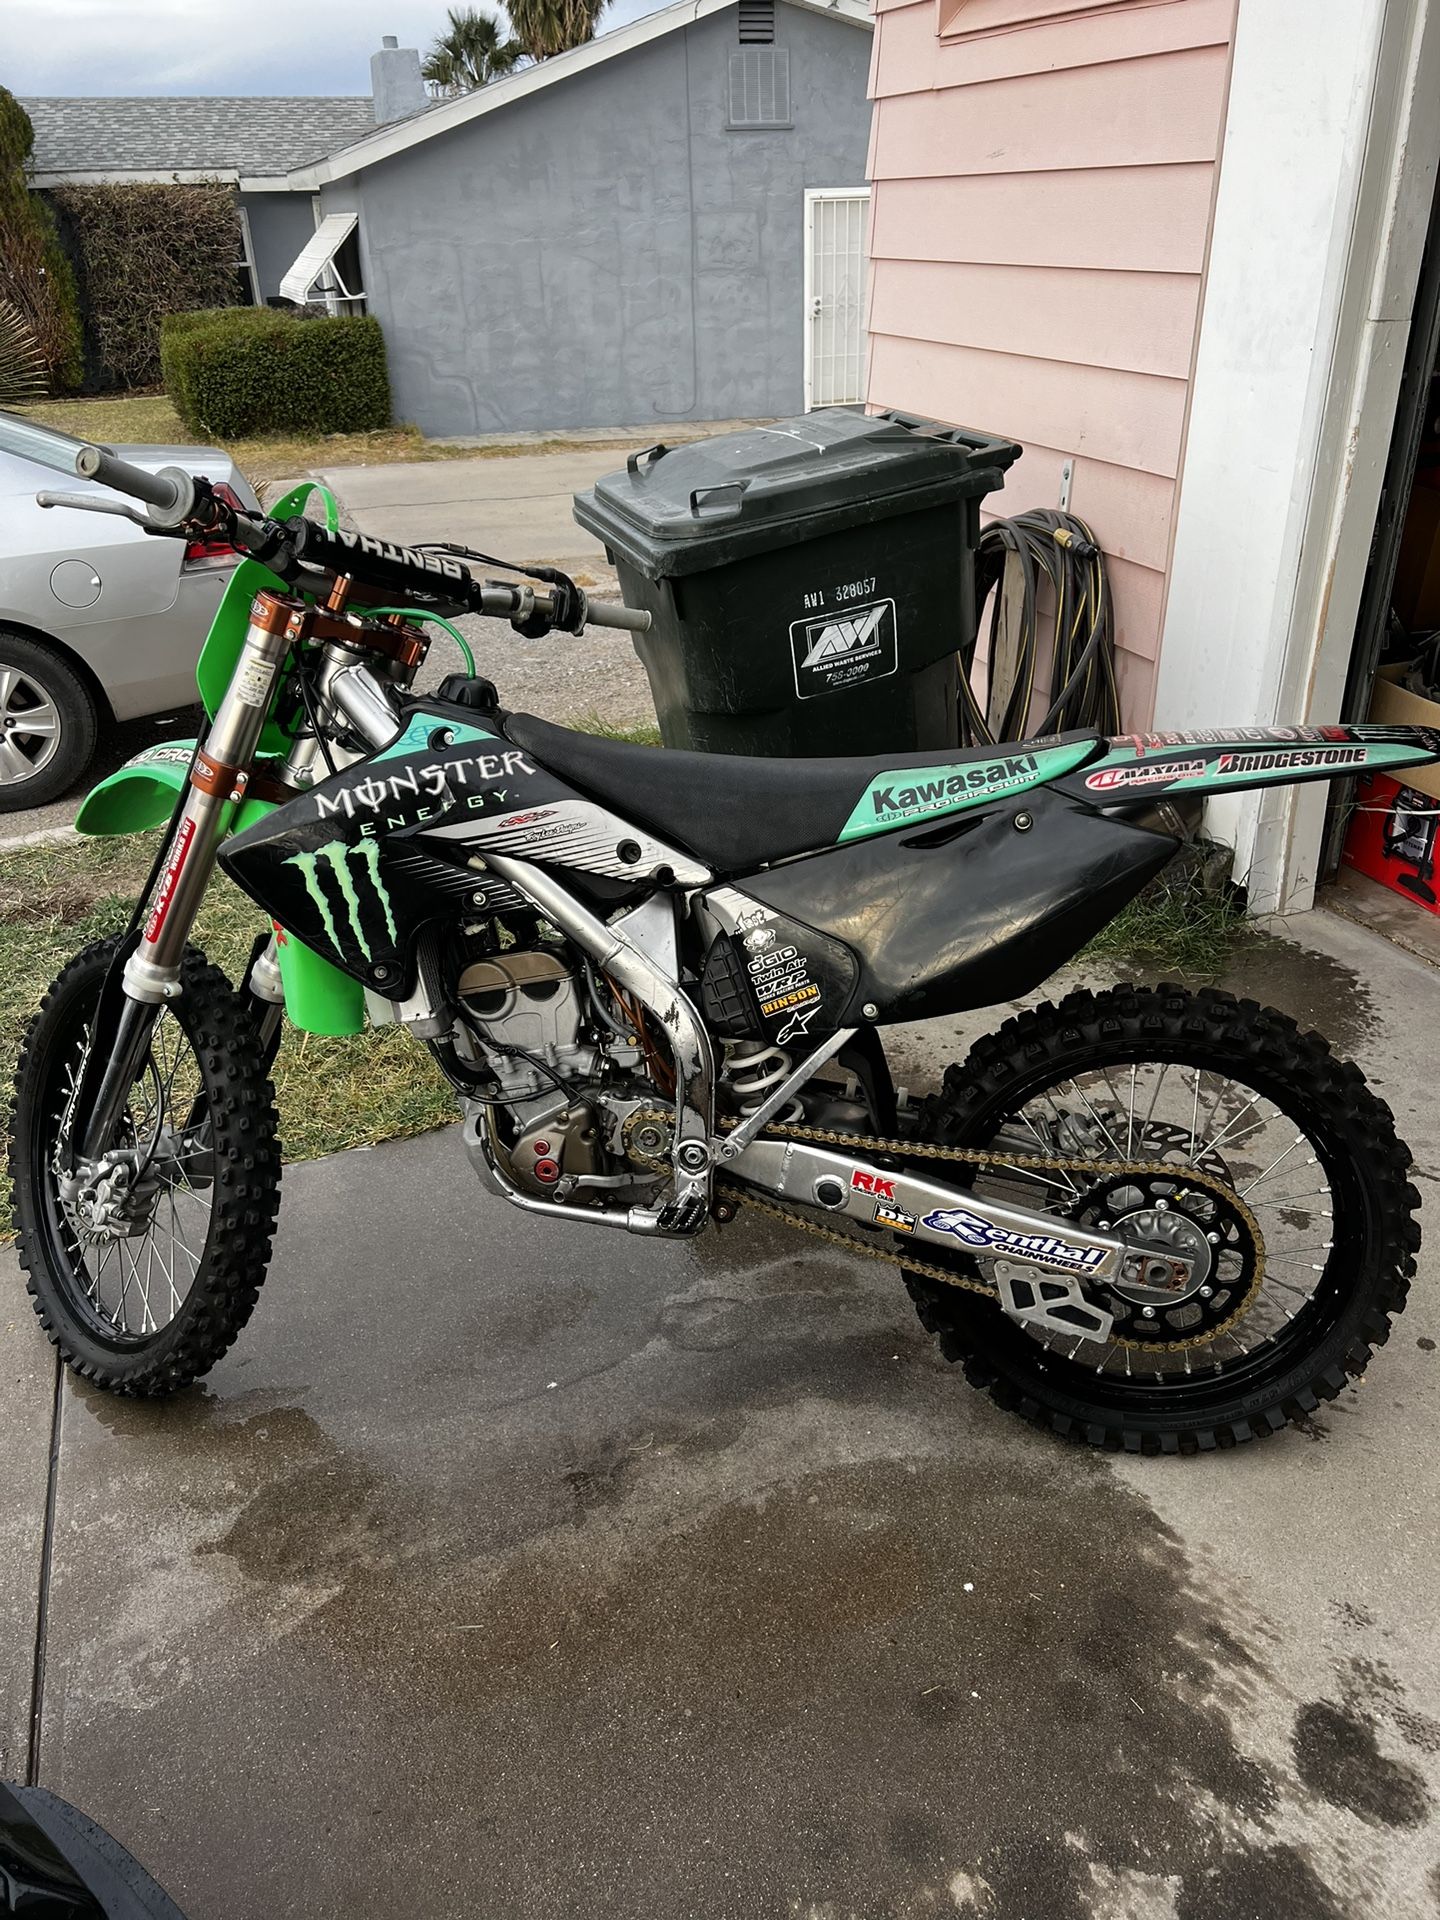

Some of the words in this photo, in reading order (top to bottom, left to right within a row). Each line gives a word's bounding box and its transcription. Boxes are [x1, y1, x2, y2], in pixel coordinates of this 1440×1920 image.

[835, 577, 876, 601] 328057
[812, 663, 834, 673] ALLIED
[834, 657, 854, 667] WASTE
[855, 649, 882, 661] SERVICES
[1217, 749, 1366, 775] BRIDGESTONE
[313, 750, 537, 819] MONSTER
[872, 754, 1039, 815] Kawasaki
[903, 799, 951, 817] PRO
[953, 772, 1040, 804] CIRCUIT
[170, 836, 190, 872] WORKS
[182, 819, 193, 839] KIT
[751, 968, 784, 985] Twin
[785, 957, 807, 973] Air
[756, 970, 807, 998] WRP
[763, 986, 818, 1013] HINSON
[776, 985, 795, 995] RACING
[852, 1171, 896, 1198] RK
[877, 1207, 915, 1225] DP
[928, 1209, 1104, 1265] Renthal
[994, 1243, 1096, 1273] CHAINWHEELS
